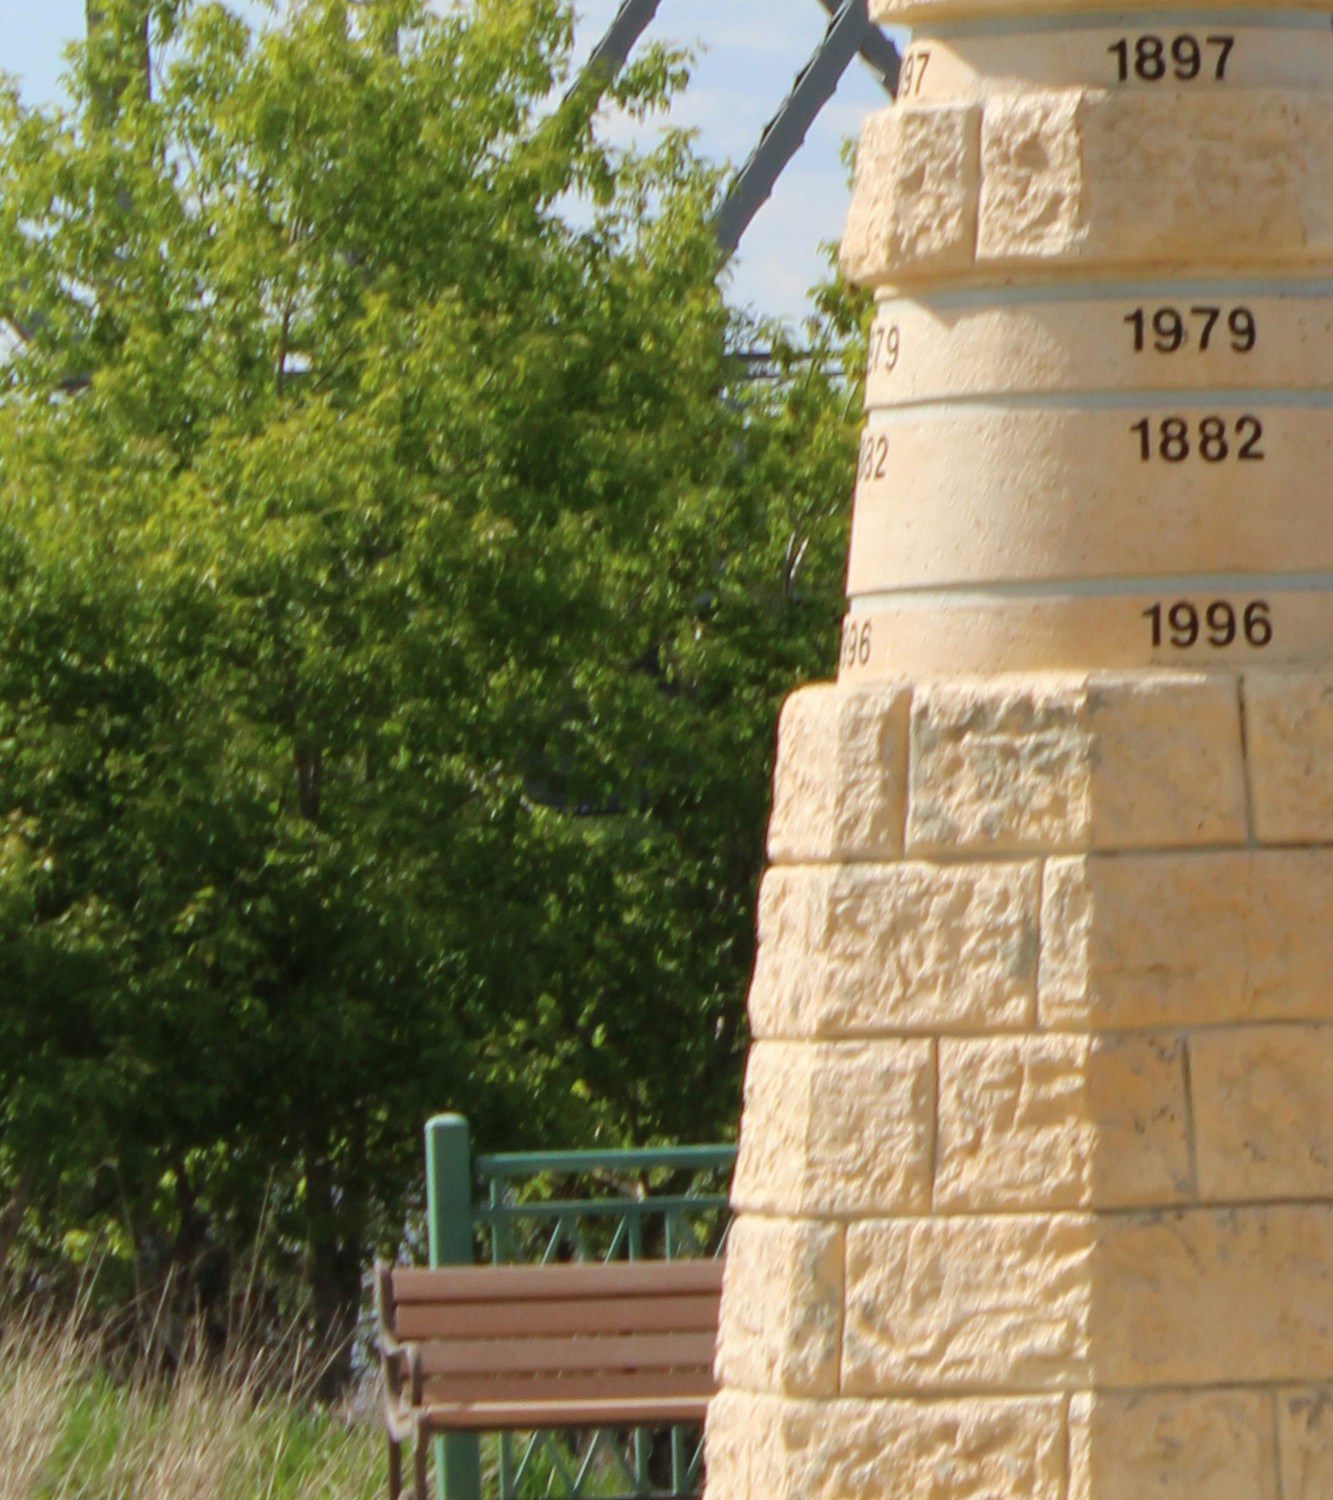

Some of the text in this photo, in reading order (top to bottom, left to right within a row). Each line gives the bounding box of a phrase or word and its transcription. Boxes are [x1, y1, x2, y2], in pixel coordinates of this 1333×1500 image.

[897, 51, 931, 99] 97
[1107, 33, 1235, 84] 1897
[868, 325, 900, 374] 79
[1123, 306, 1257, 355] 1979
[1130, 414, 1265, 464] 1882
[841, 619, 872, 669] 96
[1142, 599, 1273, 650] 1996
